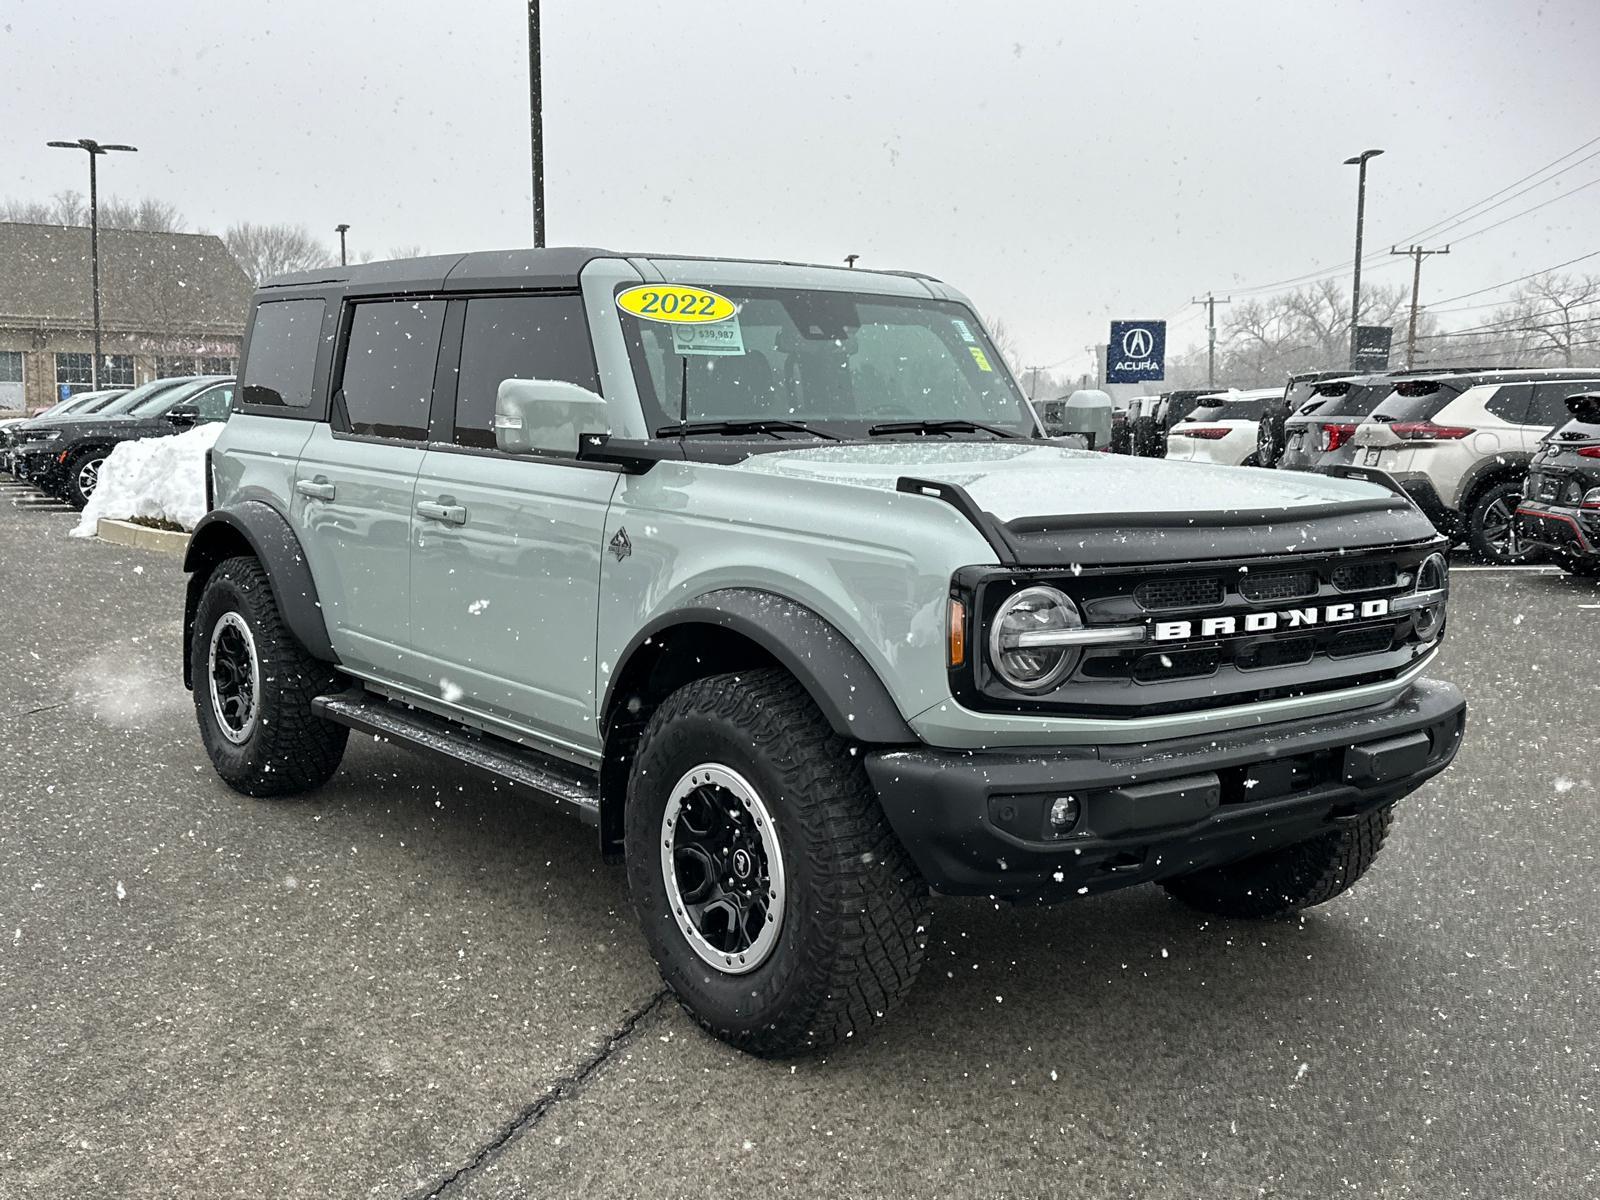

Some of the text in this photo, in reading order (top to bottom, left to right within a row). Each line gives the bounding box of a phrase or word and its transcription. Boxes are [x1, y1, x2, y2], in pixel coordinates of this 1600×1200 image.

[640, 292, 716, 316] 2022
[698, 330, 734, 340] $39,987
[1114, 361, 1159, 371] ACURA
[1155, 599, 1388, 641] BRONCO
